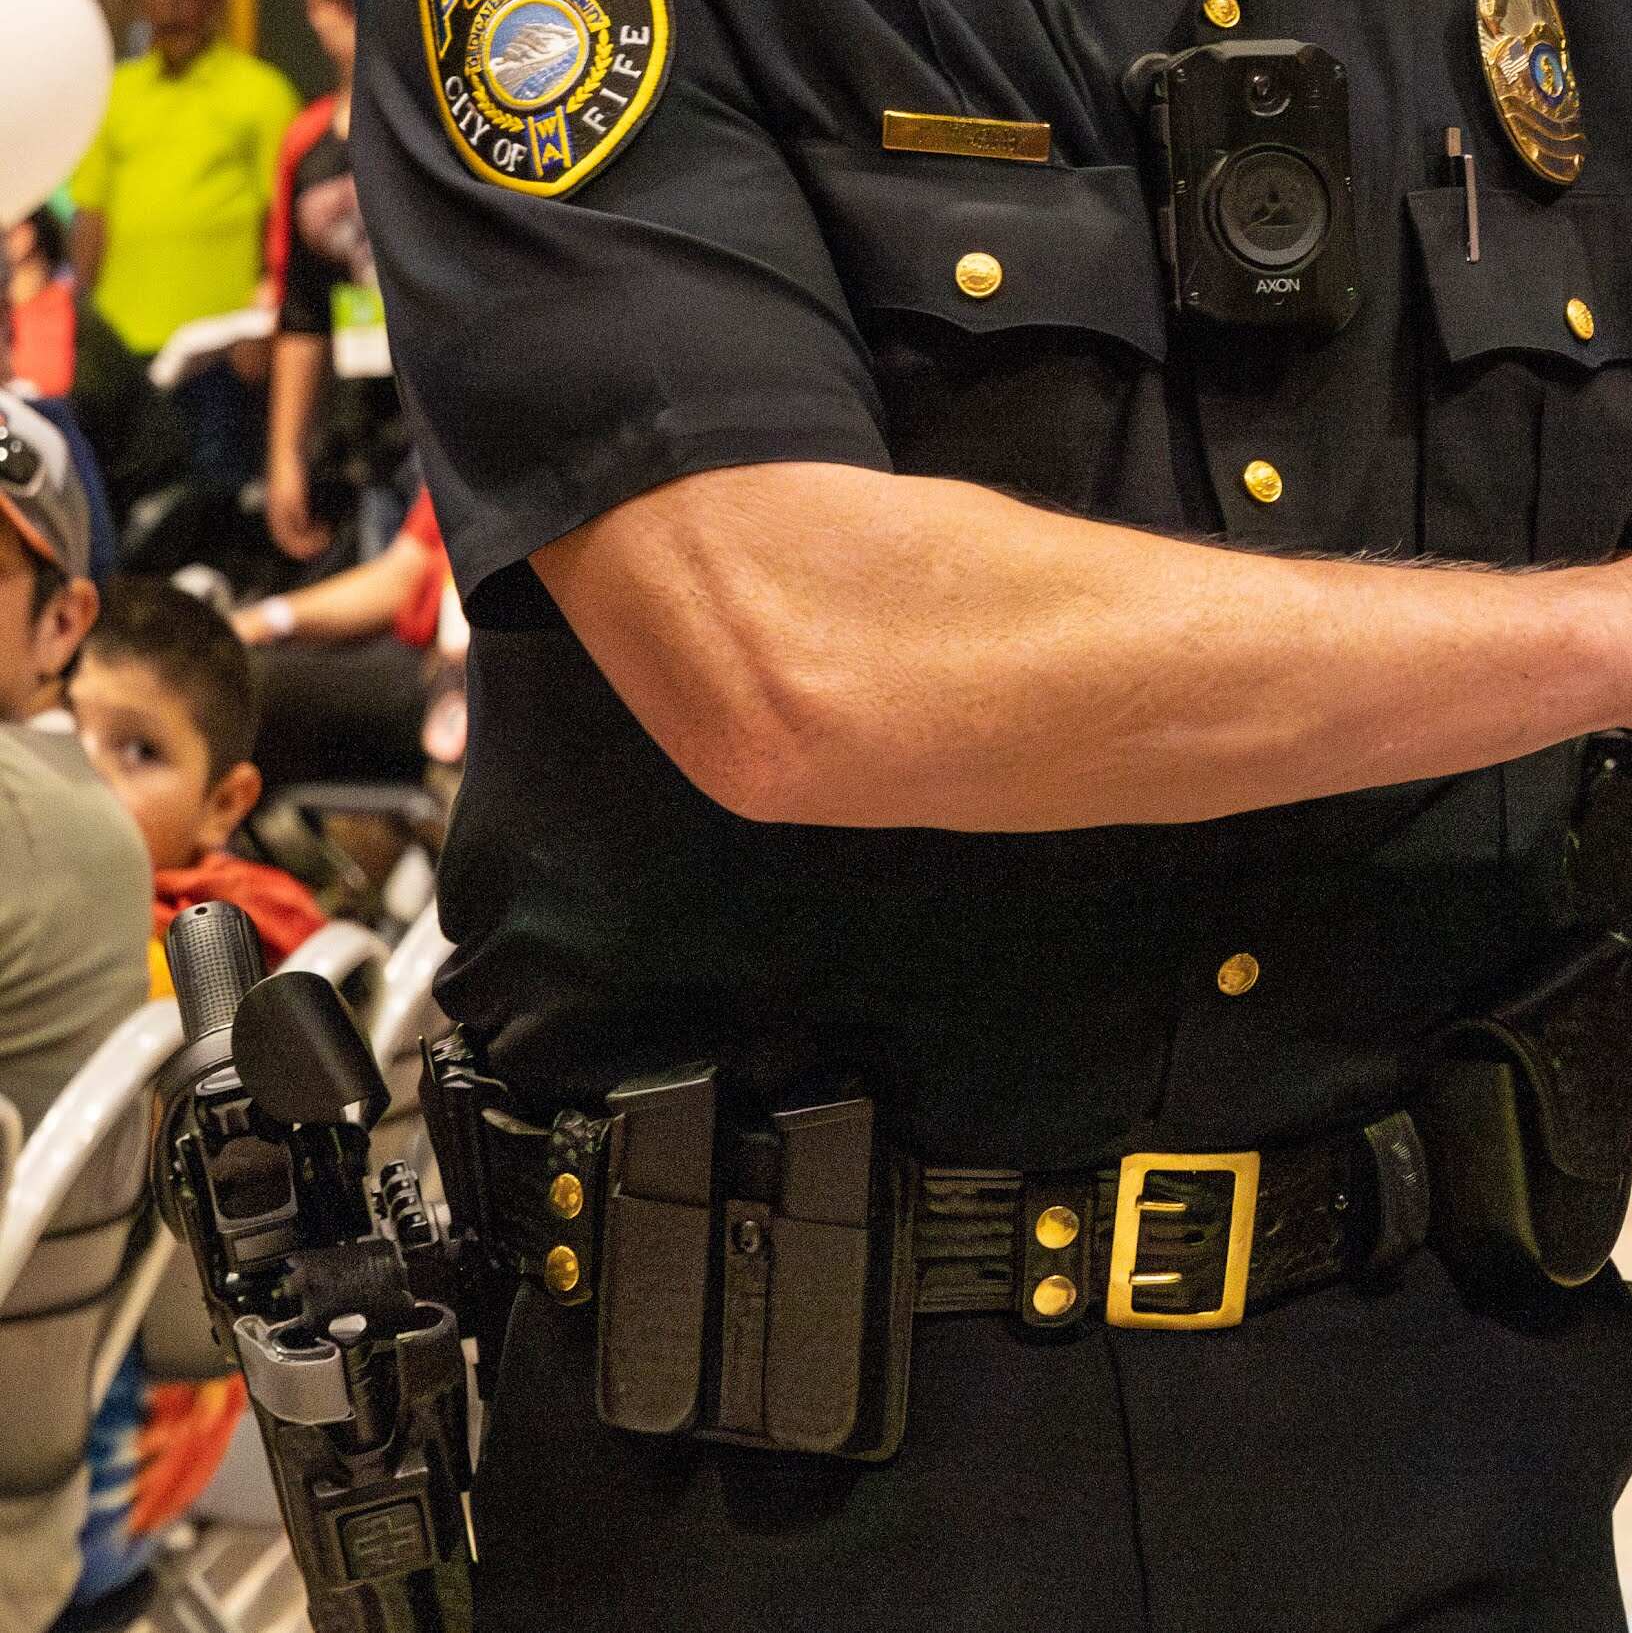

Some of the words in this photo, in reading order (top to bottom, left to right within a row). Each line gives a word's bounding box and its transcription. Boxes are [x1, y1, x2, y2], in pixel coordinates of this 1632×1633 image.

[445, 75, 491, 146] CITY
[492, 137, 529, 173] OF
[581, 24, 650, 135] FIFE
[1255, 278, 1301, 293] AXON
